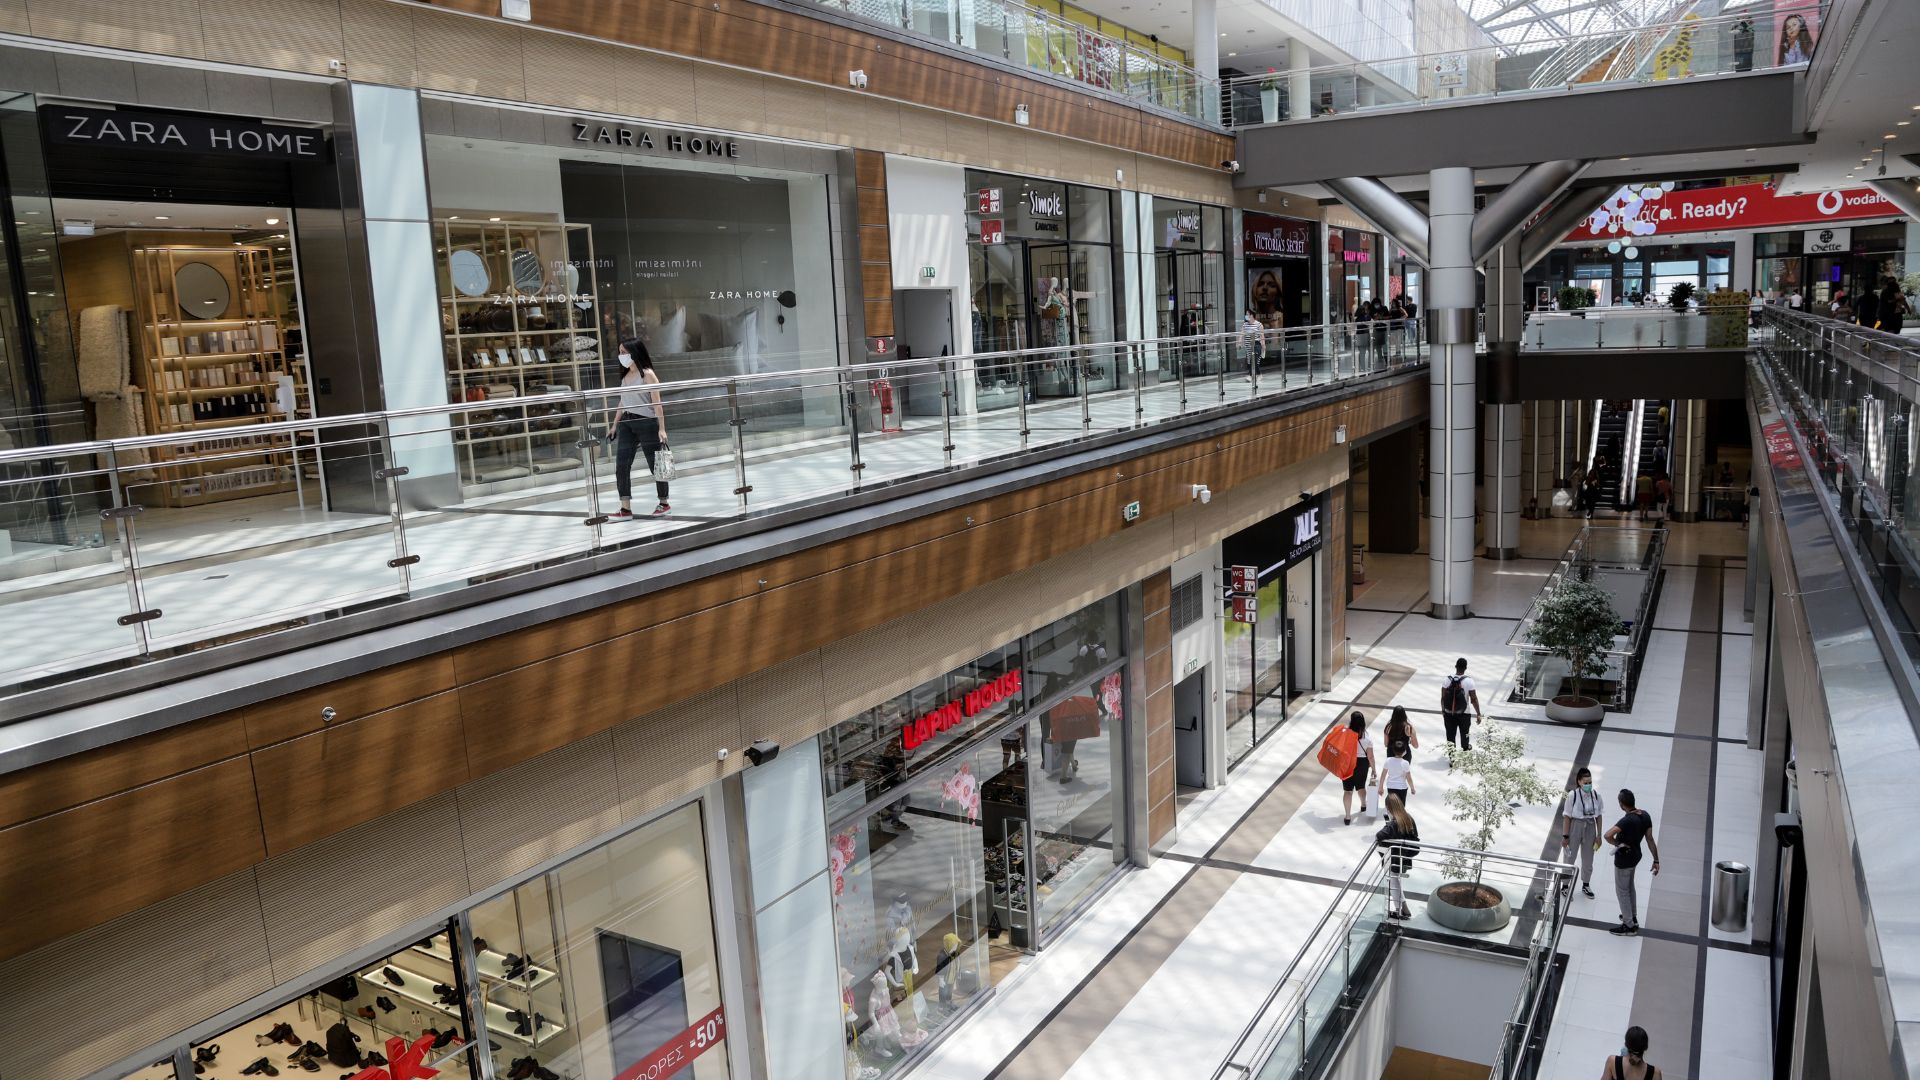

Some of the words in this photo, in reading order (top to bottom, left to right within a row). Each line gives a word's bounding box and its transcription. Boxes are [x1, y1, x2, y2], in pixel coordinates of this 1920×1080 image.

[64, 115, 188, 146] ZARA
[209, 128, 317, 156] HOME
[574, 123, 655, 149] ZARA
[668, 135, 742, 159] HOME
[1682, 197, 1748, 220] Ready?
[1286, 238, 1305, 254] SECRET
[493, 294, 538, 304] ZARA
[546, 293, 590, 303] HOME
[709, 291, 742, 300] ZARA
[746, 290, 779, 298] HOME
[903, 699, 963, 751] LAPIN
[965, 668, 1022, 717] HOUSE
[689, 1013, 724, 1048] -50%
